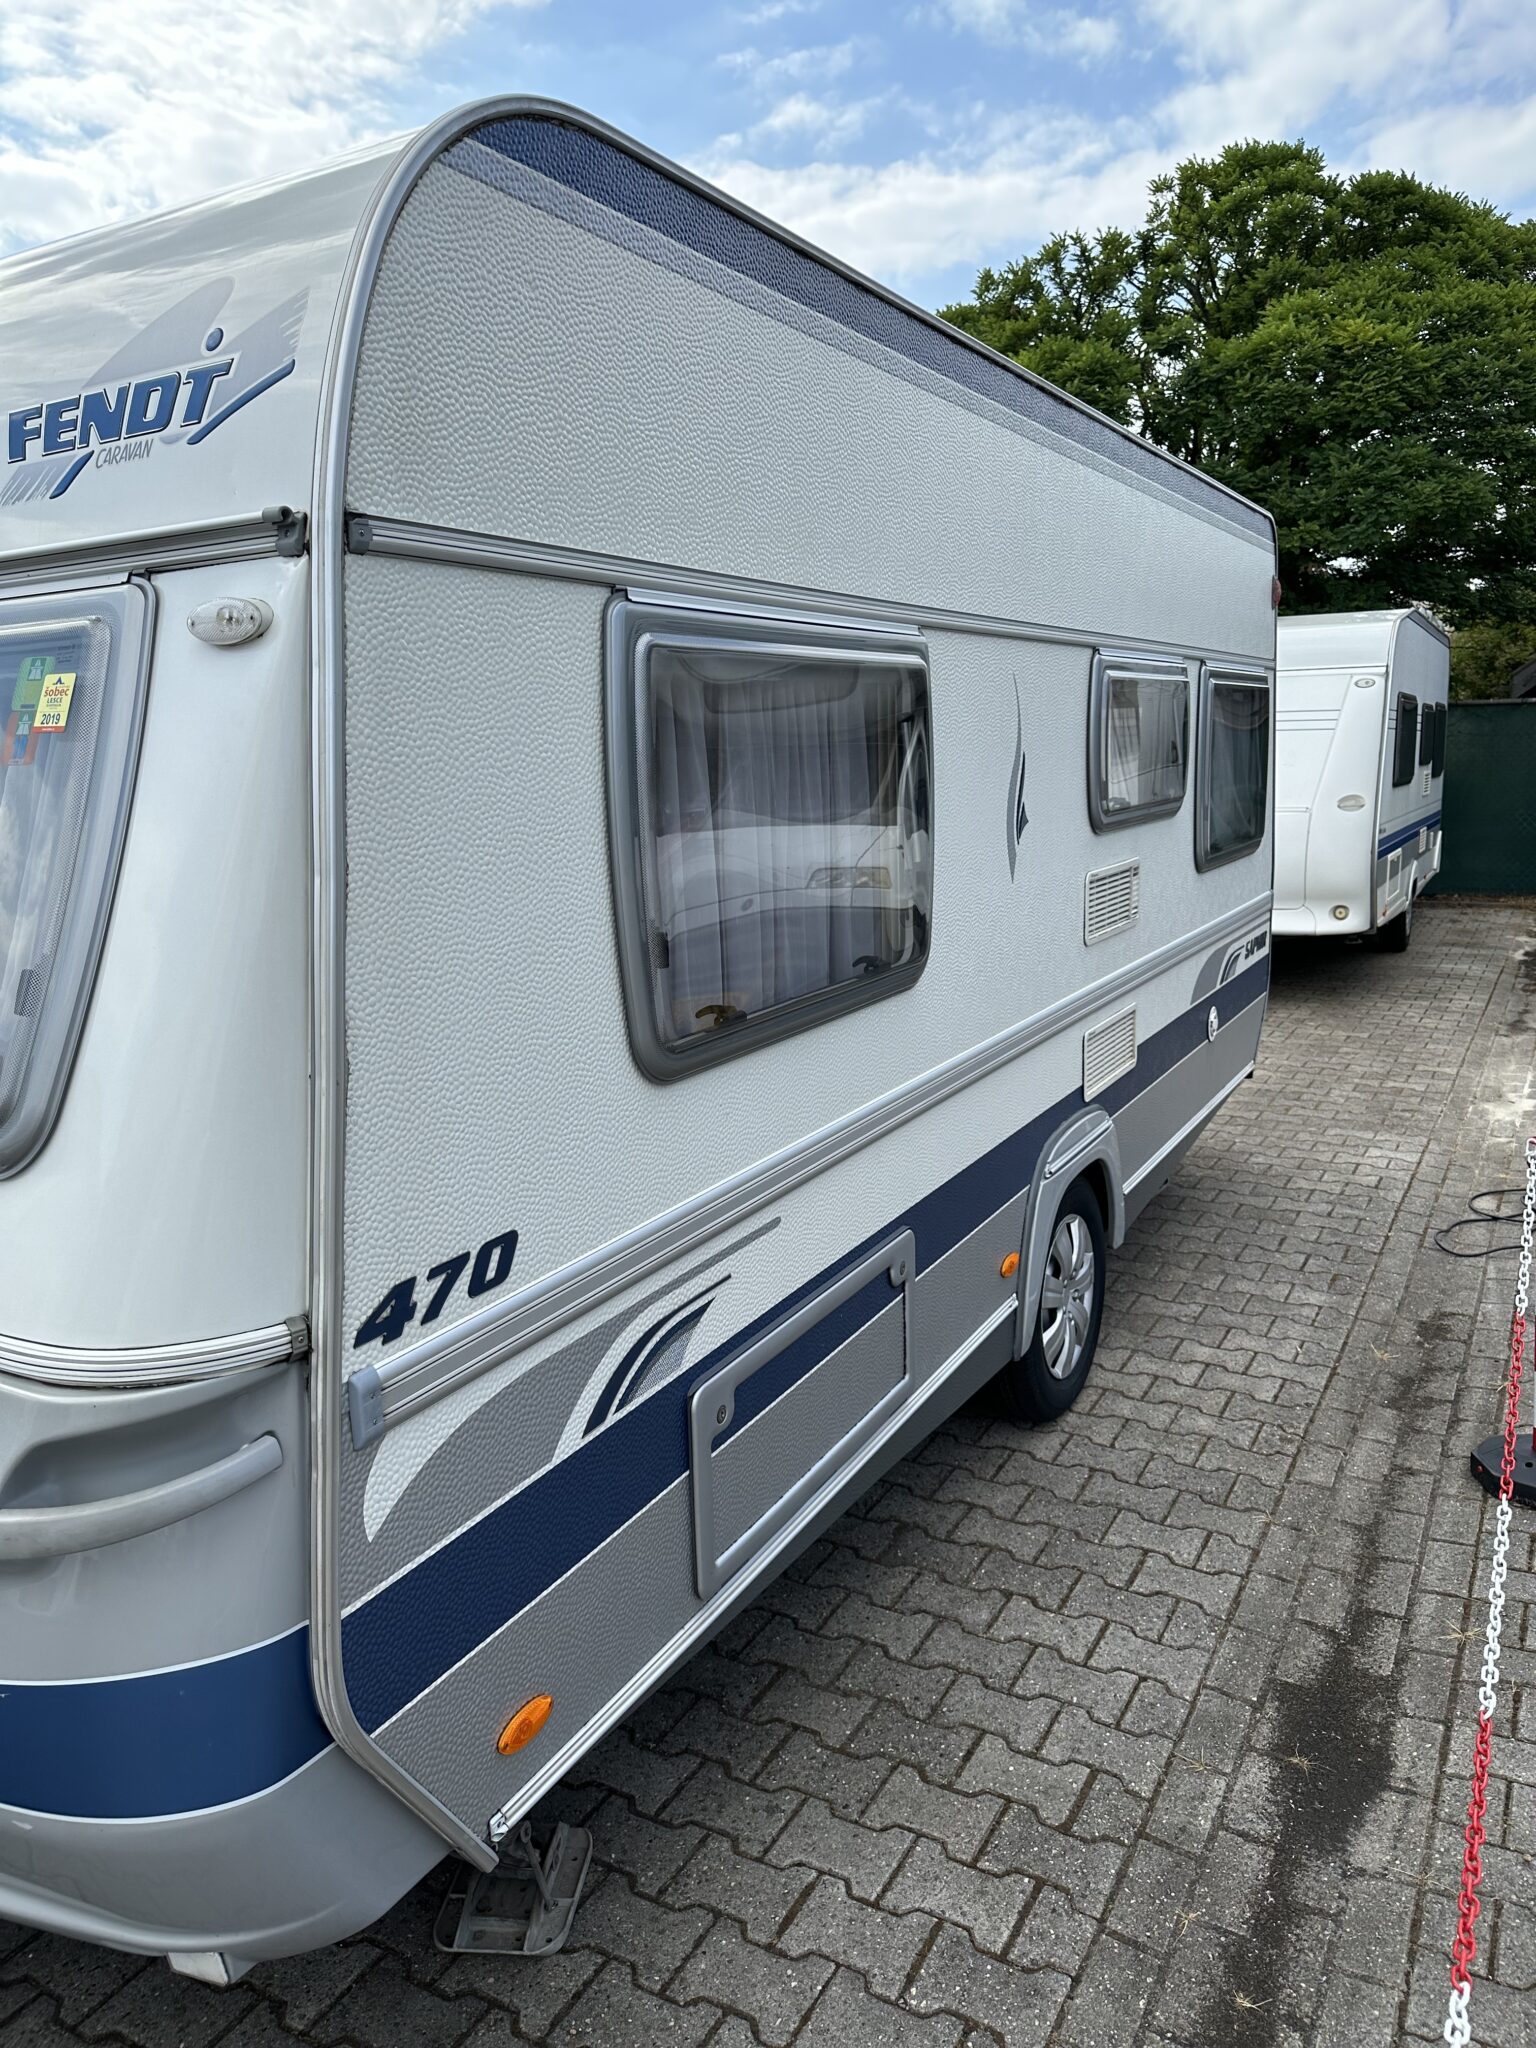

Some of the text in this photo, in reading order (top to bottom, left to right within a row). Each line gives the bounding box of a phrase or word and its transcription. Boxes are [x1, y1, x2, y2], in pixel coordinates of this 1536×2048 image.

[8, 357, 234, 464] FENDT
[96, 440, 153, 469] CARAVAN
[40, 713, 61, 725] 2019
[353, 1229, 519, 1349] 470
